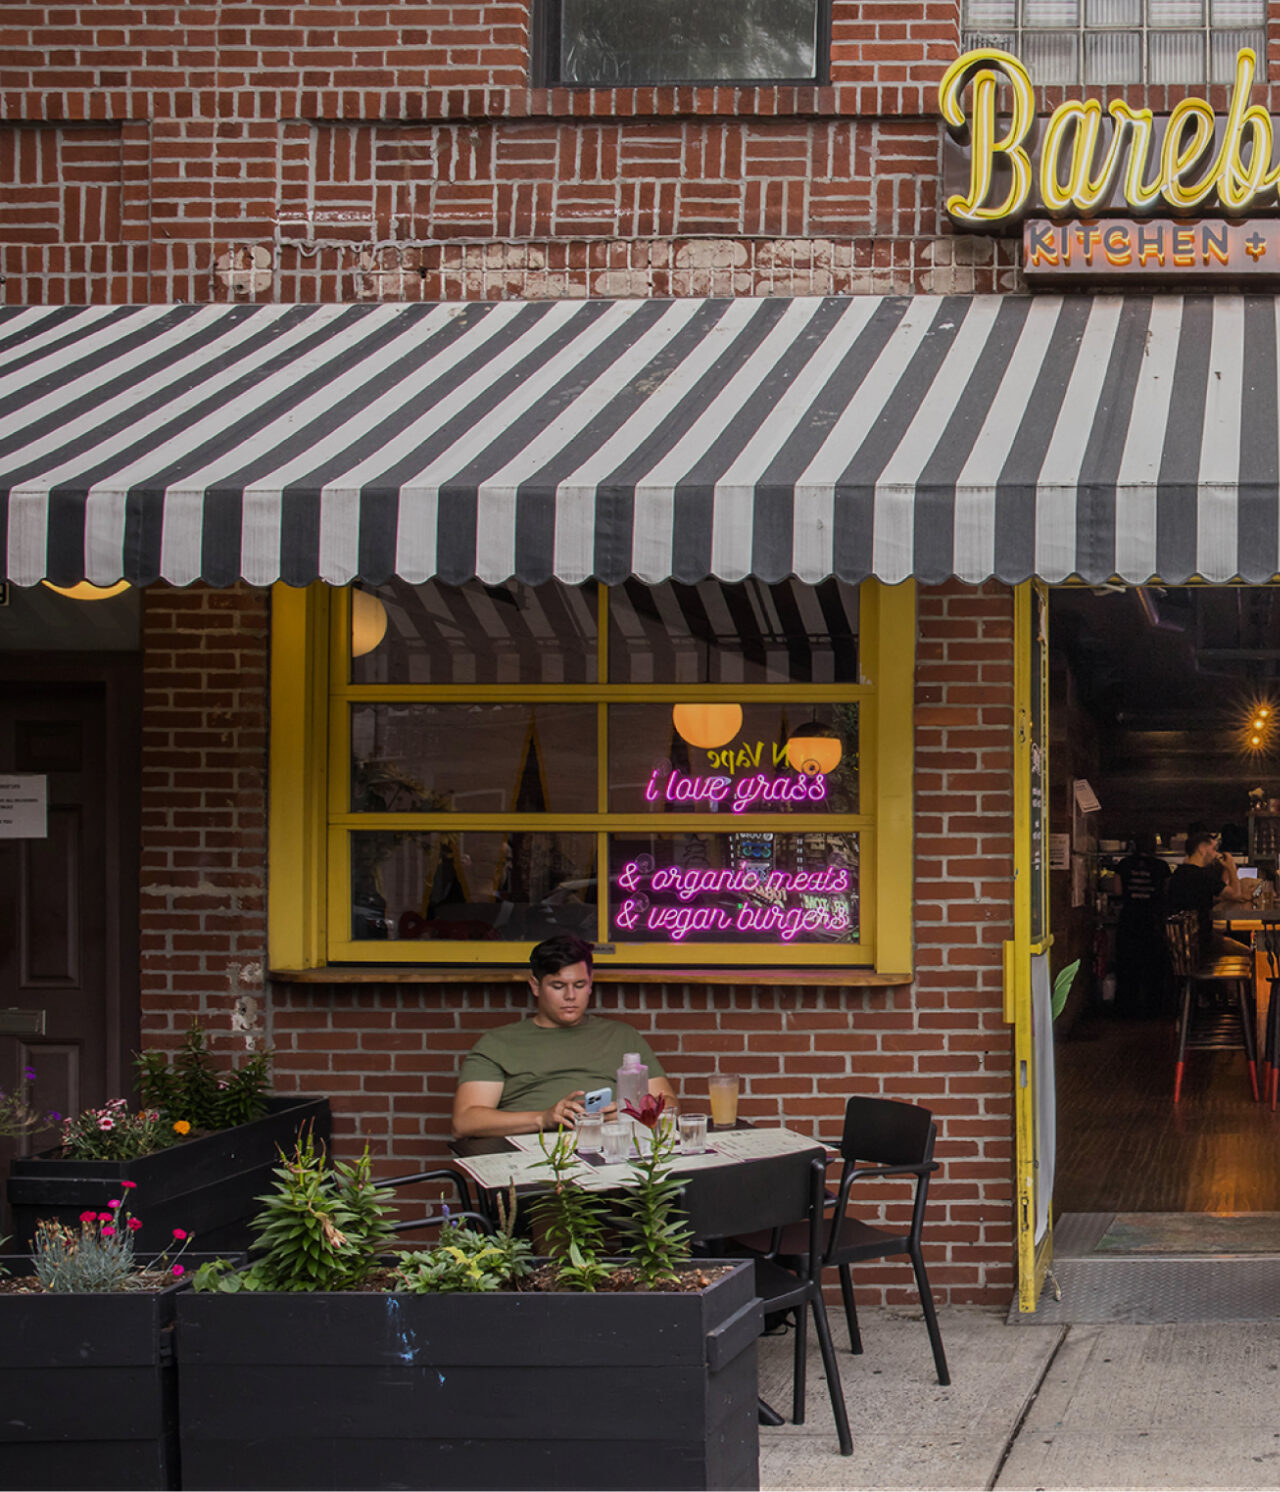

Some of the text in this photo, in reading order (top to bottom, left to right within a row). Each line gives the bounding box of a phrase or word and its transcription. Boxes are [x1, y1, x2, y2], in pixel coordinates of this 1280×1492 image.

[1030, 225, 1229, 267] KITCHEN
[646, 770, 826, 812] i love grass
[618, 862, 640, 891] &
[651, 860, 760, 899] organic
[766, 867, 848, 891] meats
[616, 900, 849, 940] & vegan burgers
